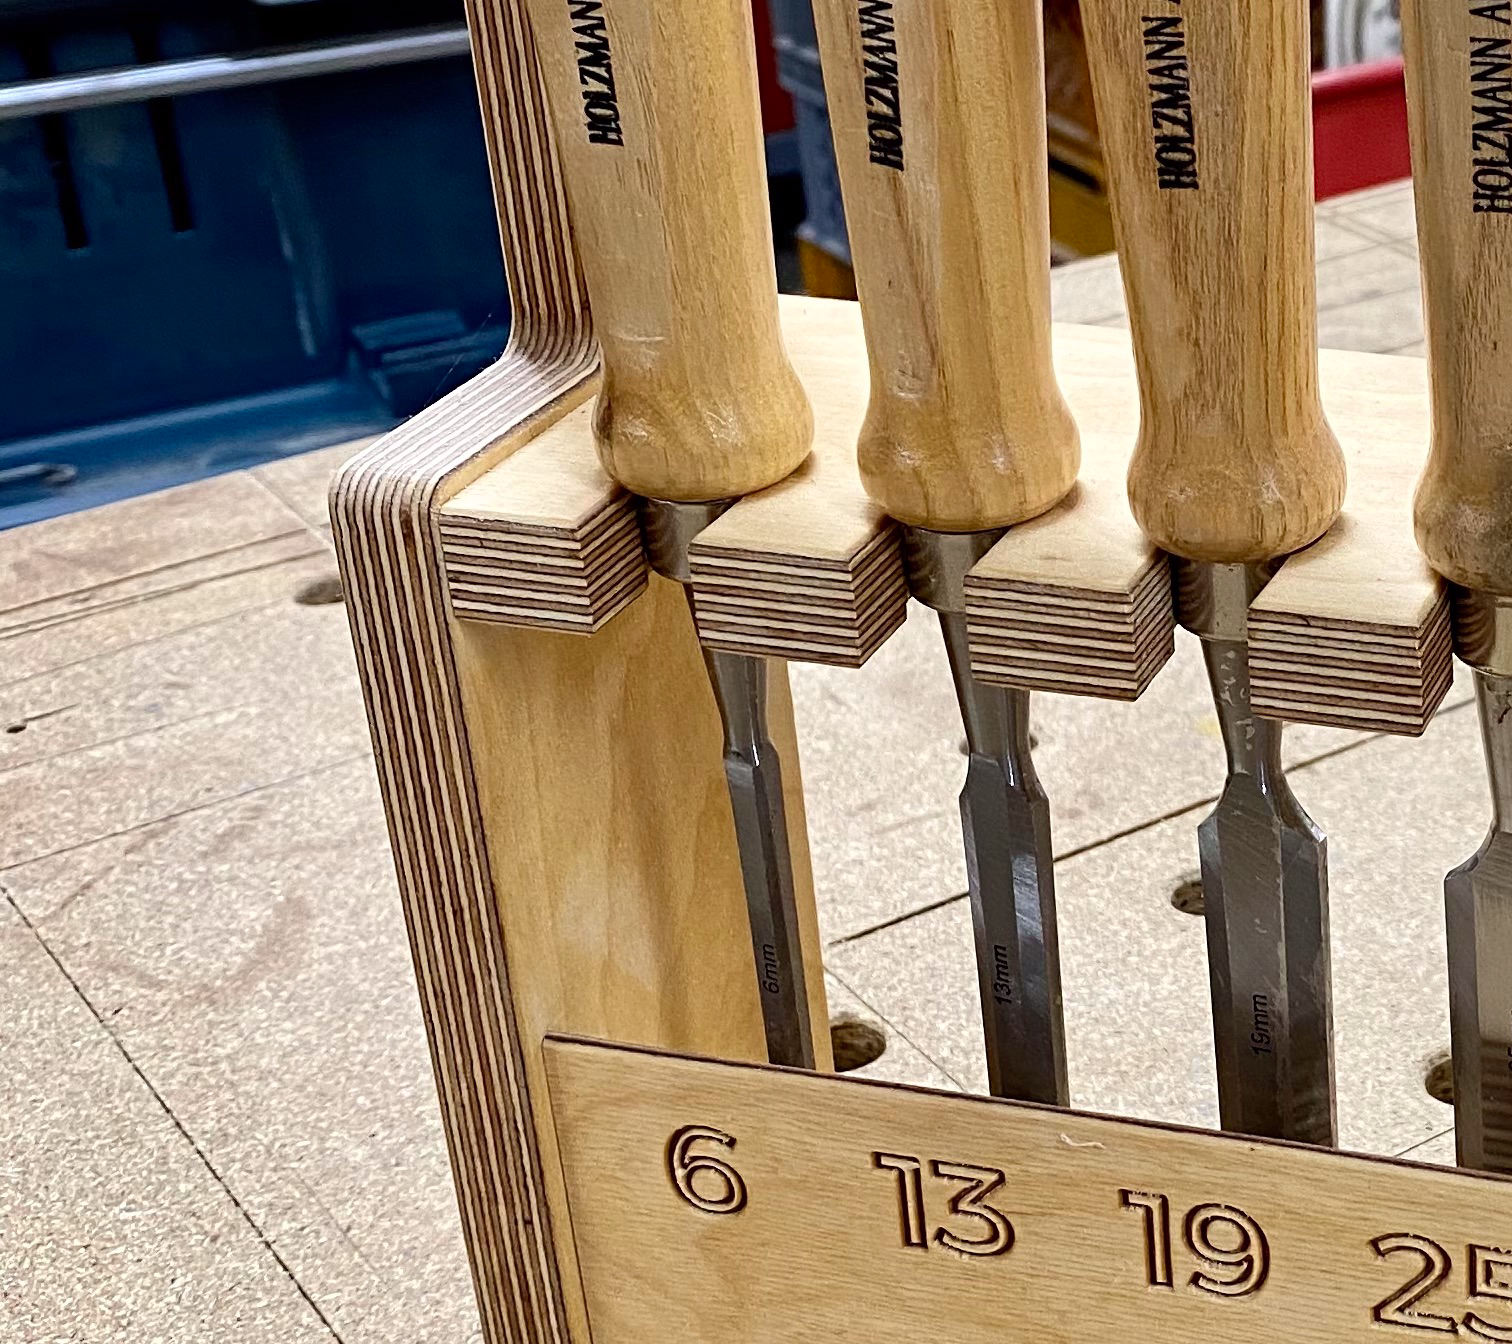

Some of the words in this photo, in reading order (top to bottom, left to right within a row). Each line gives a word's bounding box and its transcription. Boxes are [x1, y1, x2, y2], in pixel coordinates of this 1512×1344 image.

[1141, 16, 1200, 191] HOLZMANN
[762, 942, 781, 995] 6mm
[993, 944, 1013, 1005] 13mm
[1251, 994, 1272, 1057] 19mm
[665, 1124, 749, 1216] 6
[871, 1150, 1017, 1259] 13
[1119, 1187, 1271, 1298] 19
